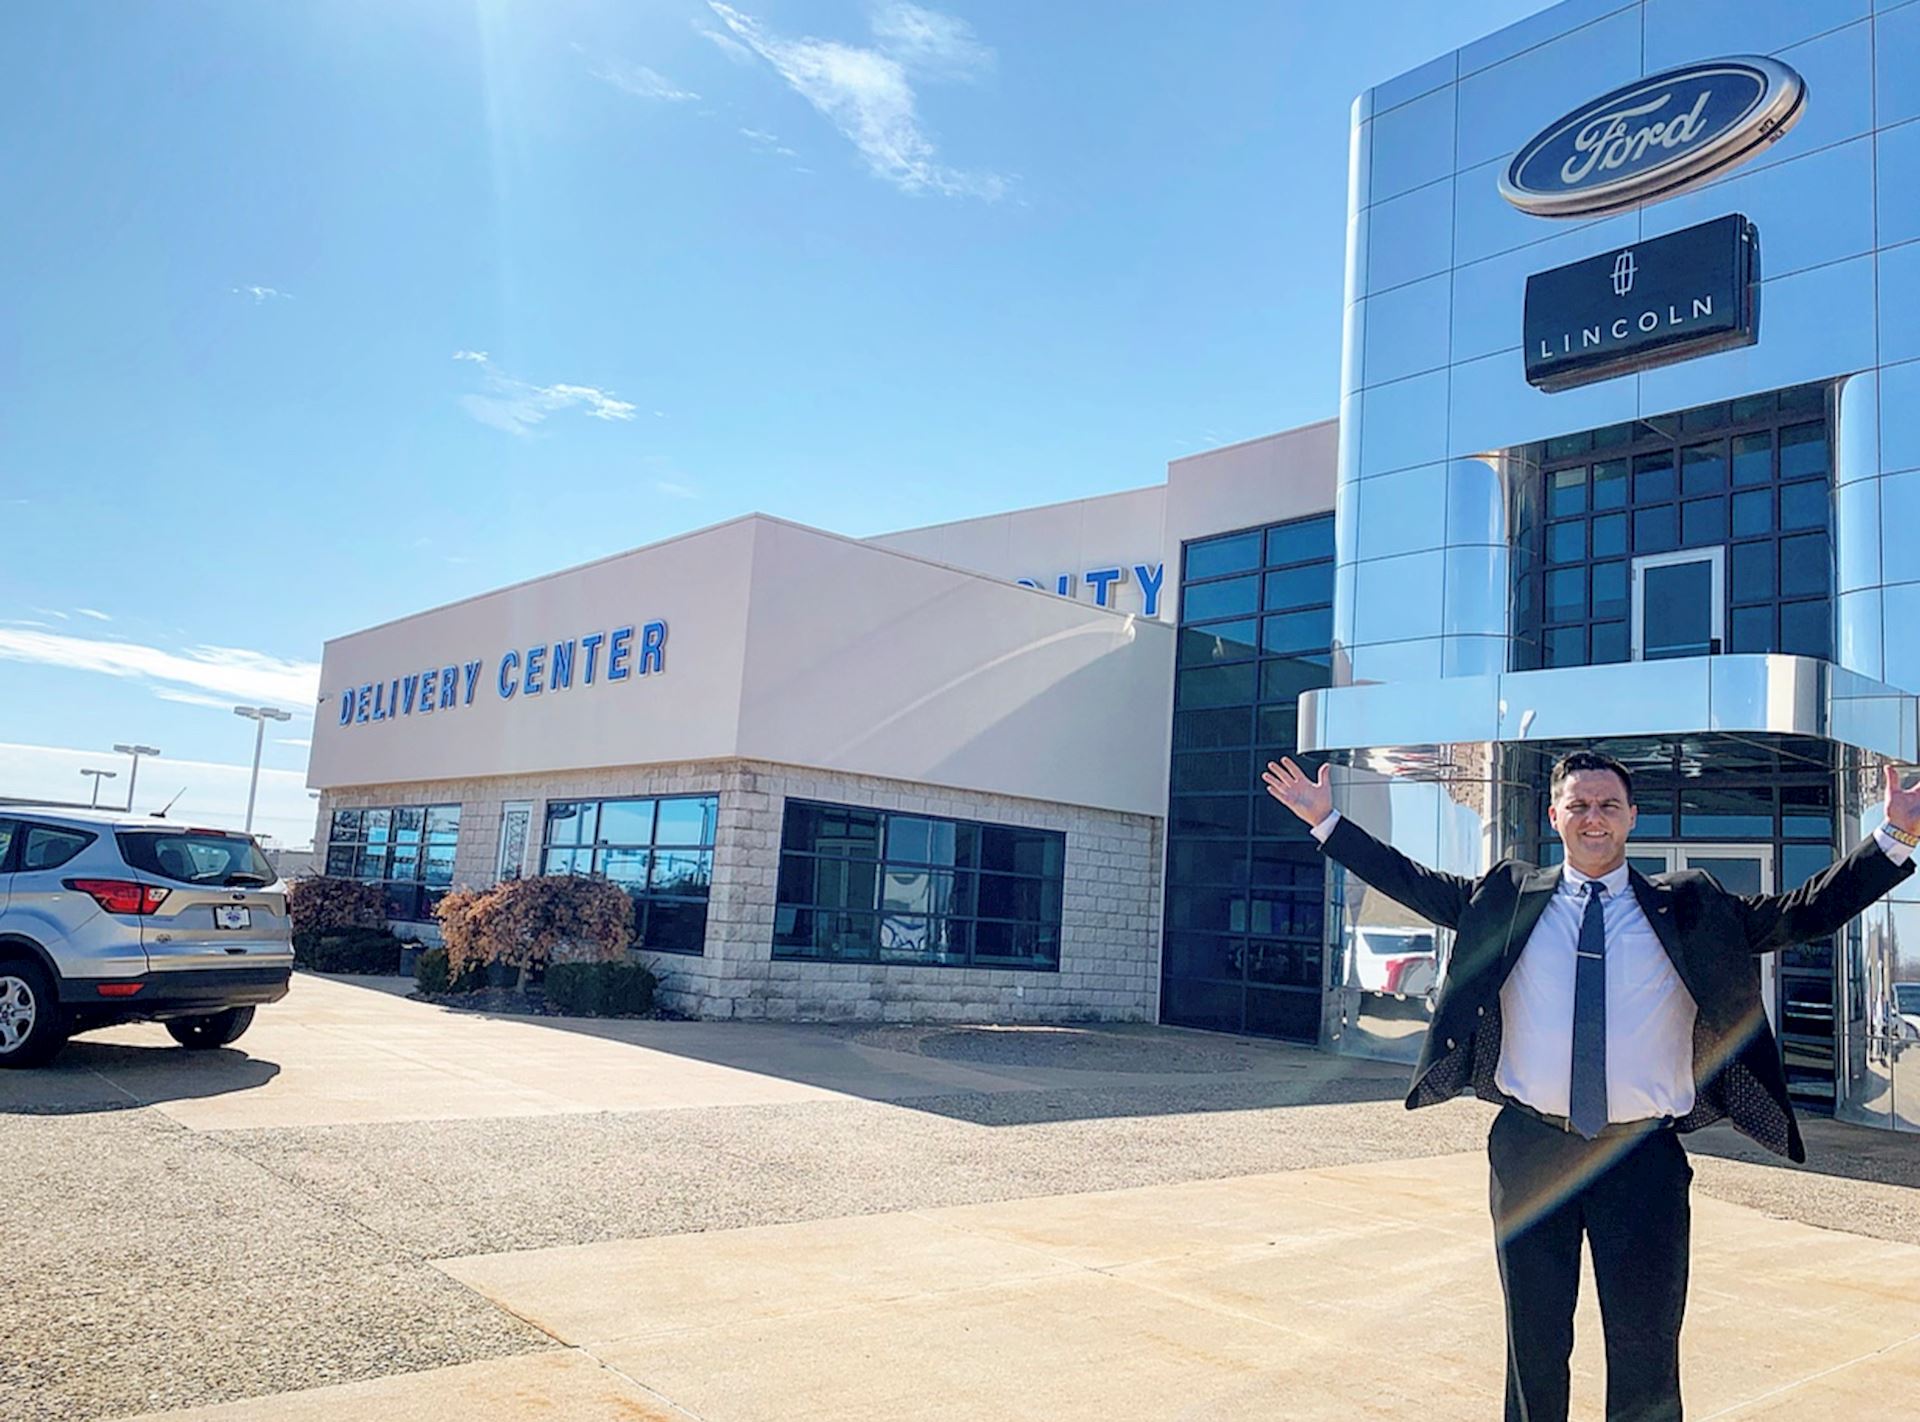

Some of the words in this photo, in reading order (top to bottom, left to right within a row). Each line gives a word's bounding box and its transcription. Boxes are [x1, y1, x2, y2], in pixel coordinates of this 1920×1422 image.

[1562, 91, 1712, 184] Ford
[1541, 296, 1713, 357] LINCOLN
[1016, 563, 1164, 616] TY
[340, 661, 482, 726] DELIVERY
[499, 618, 667, 701] CENTER
